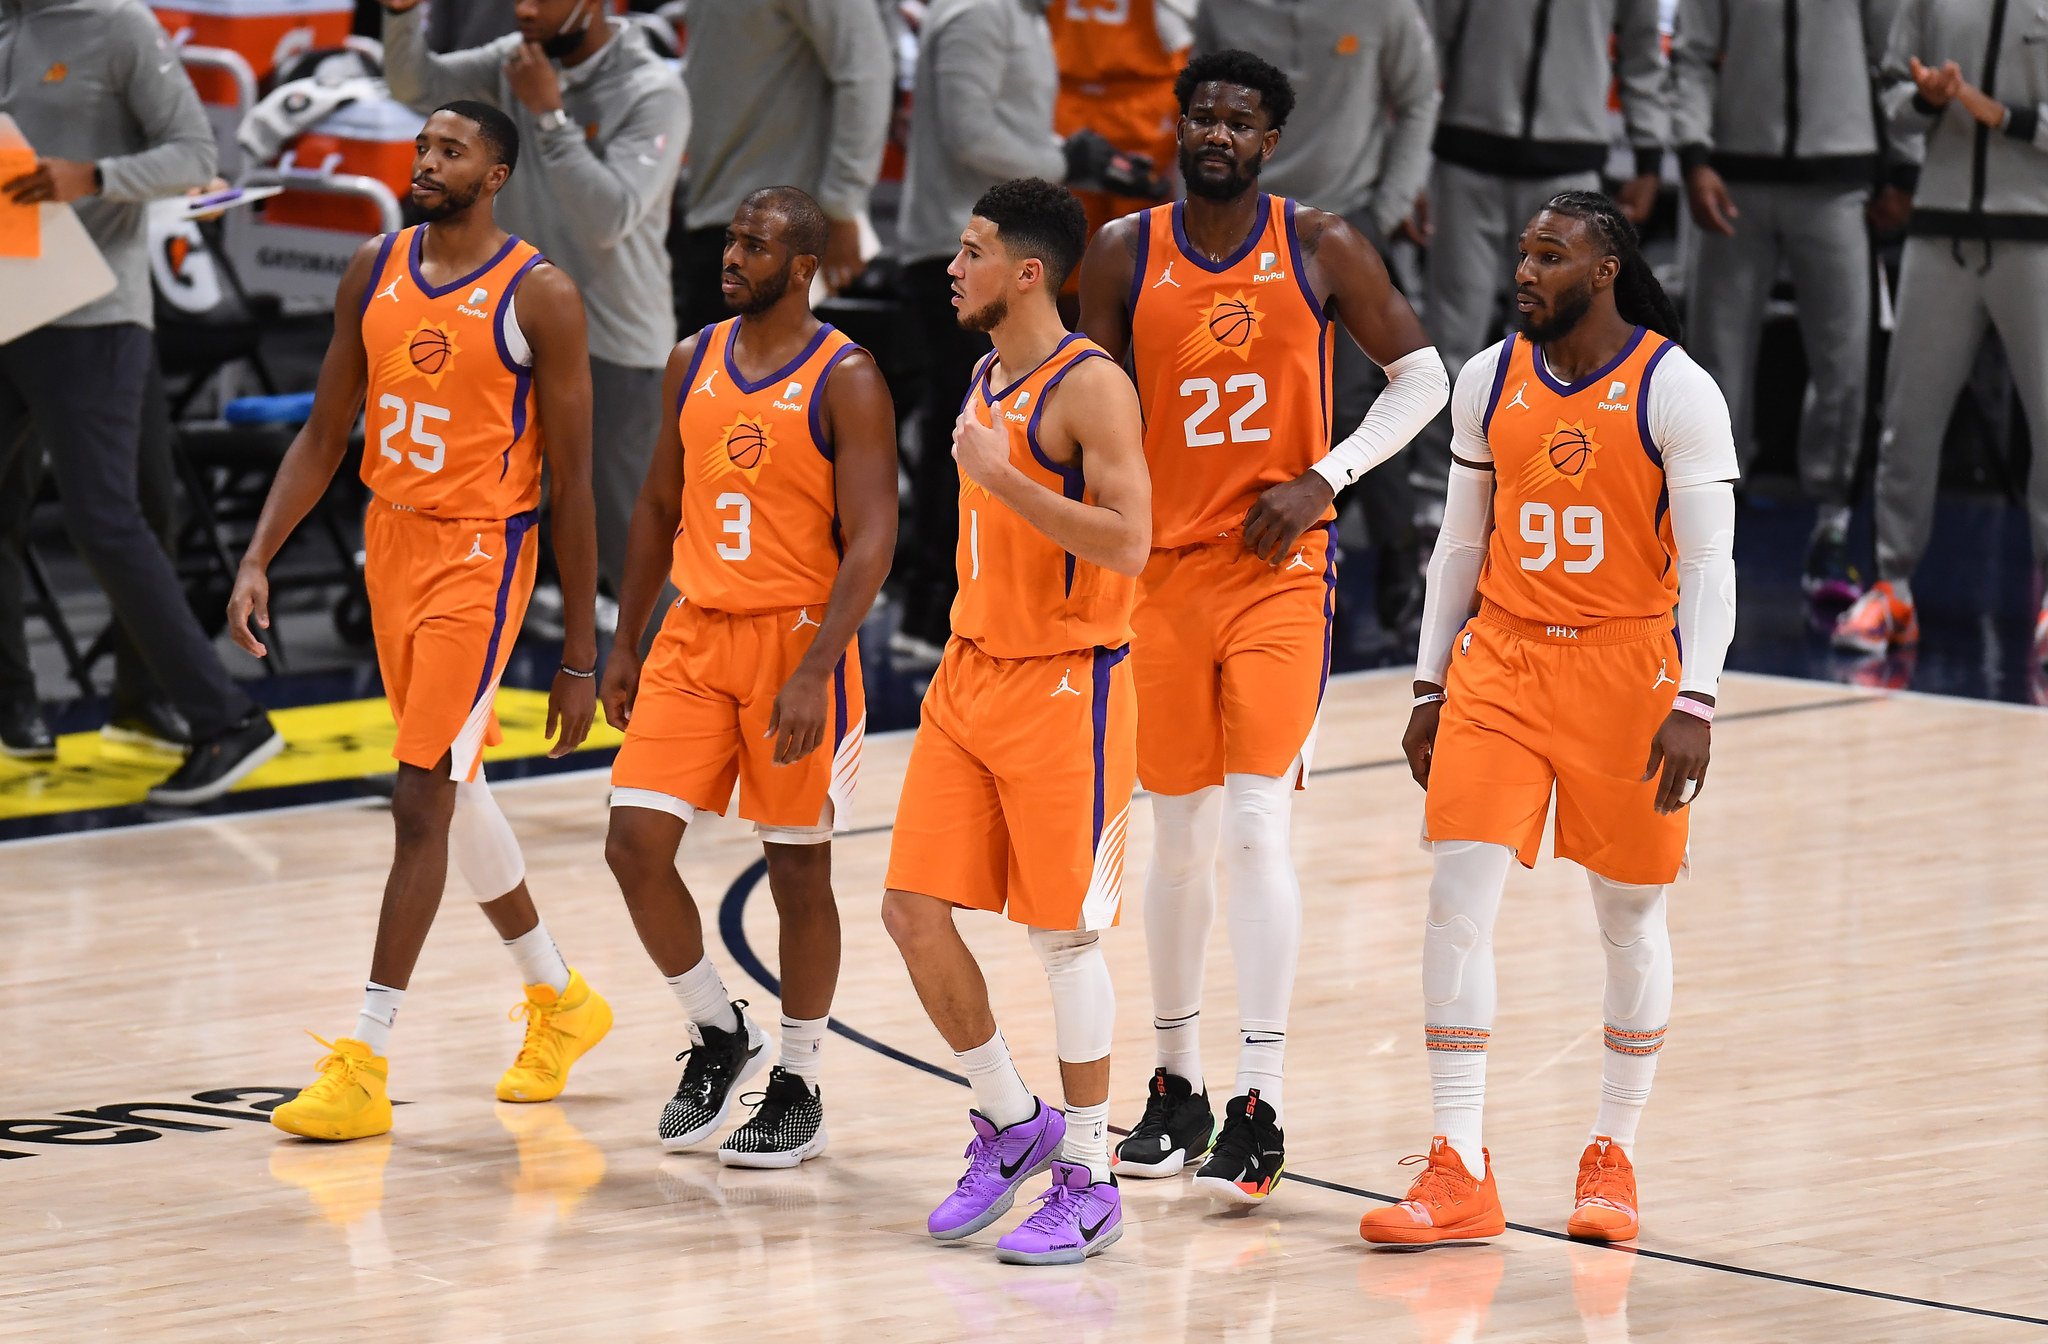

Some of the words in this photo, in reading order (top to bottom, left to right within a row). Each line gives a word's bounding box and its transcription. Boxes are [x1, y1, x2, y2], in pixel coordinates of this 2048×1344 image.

[1253, 271, 1285, 282] PayPal
[457, 304, 488, 319] PayPal
[772, 400, 803, 411] PayPal
[1004, 410, 1028, 422] PayPal
[1180, 373, 1271, 447] 22
[1597, 401, 1630, 412] PayPal
[379, 392, 451, 474] 25
[716, 492, 752, 561] 3
[970, 509, 979, 580] 1
[1519, 501, 1605, 574] 99
[1546, 625, 1579, 640] PHX
[0, 1086, 416, 1160] en
